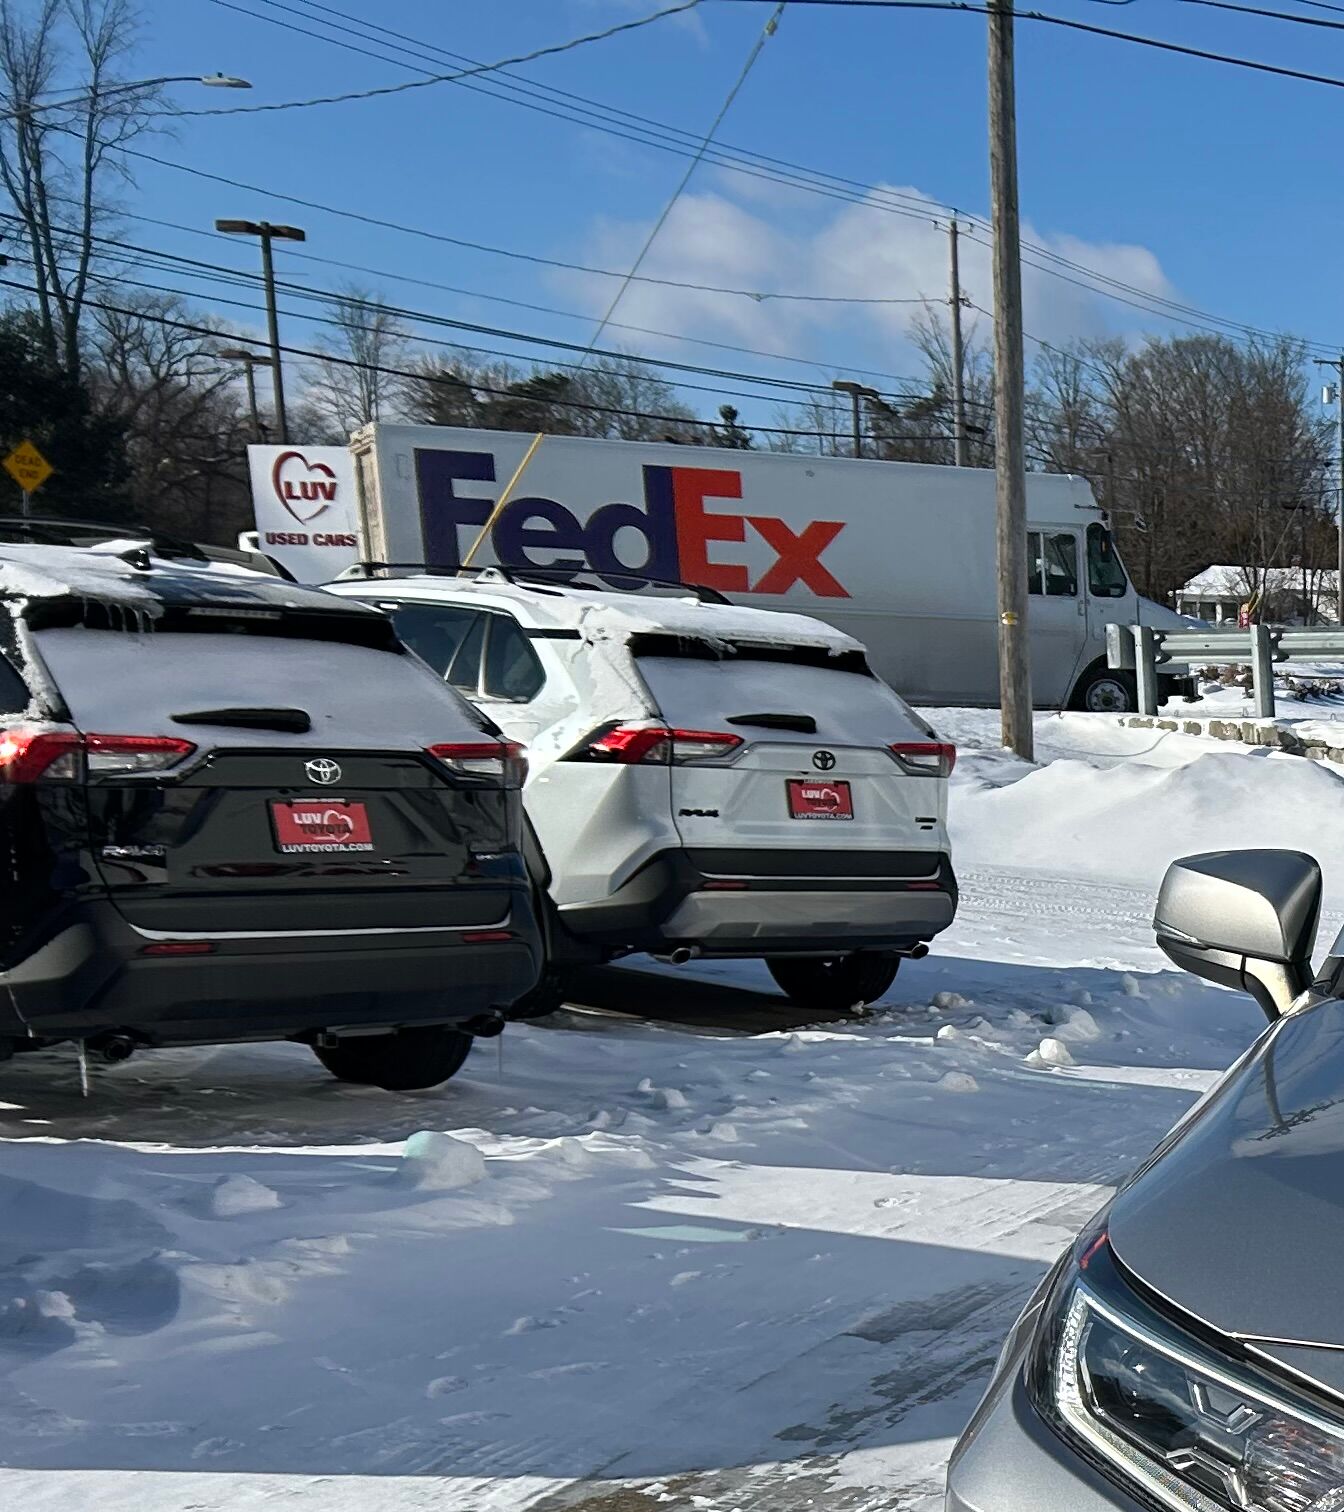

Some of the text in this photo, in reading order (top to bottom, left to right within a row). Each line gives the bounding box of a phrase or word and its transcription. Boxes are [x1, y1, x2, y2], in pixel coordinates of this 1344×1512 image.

[284, 481, 338, 500] LUV
[414, 447, 852, 598] FedEx
[265, 532, 358, 547] USED CARS
[293, 813, 321, 824] LUV
[301, 824, 353, 835] TOYOTA
[281, 843, 374, 853] LUVTOYOTA.COM
